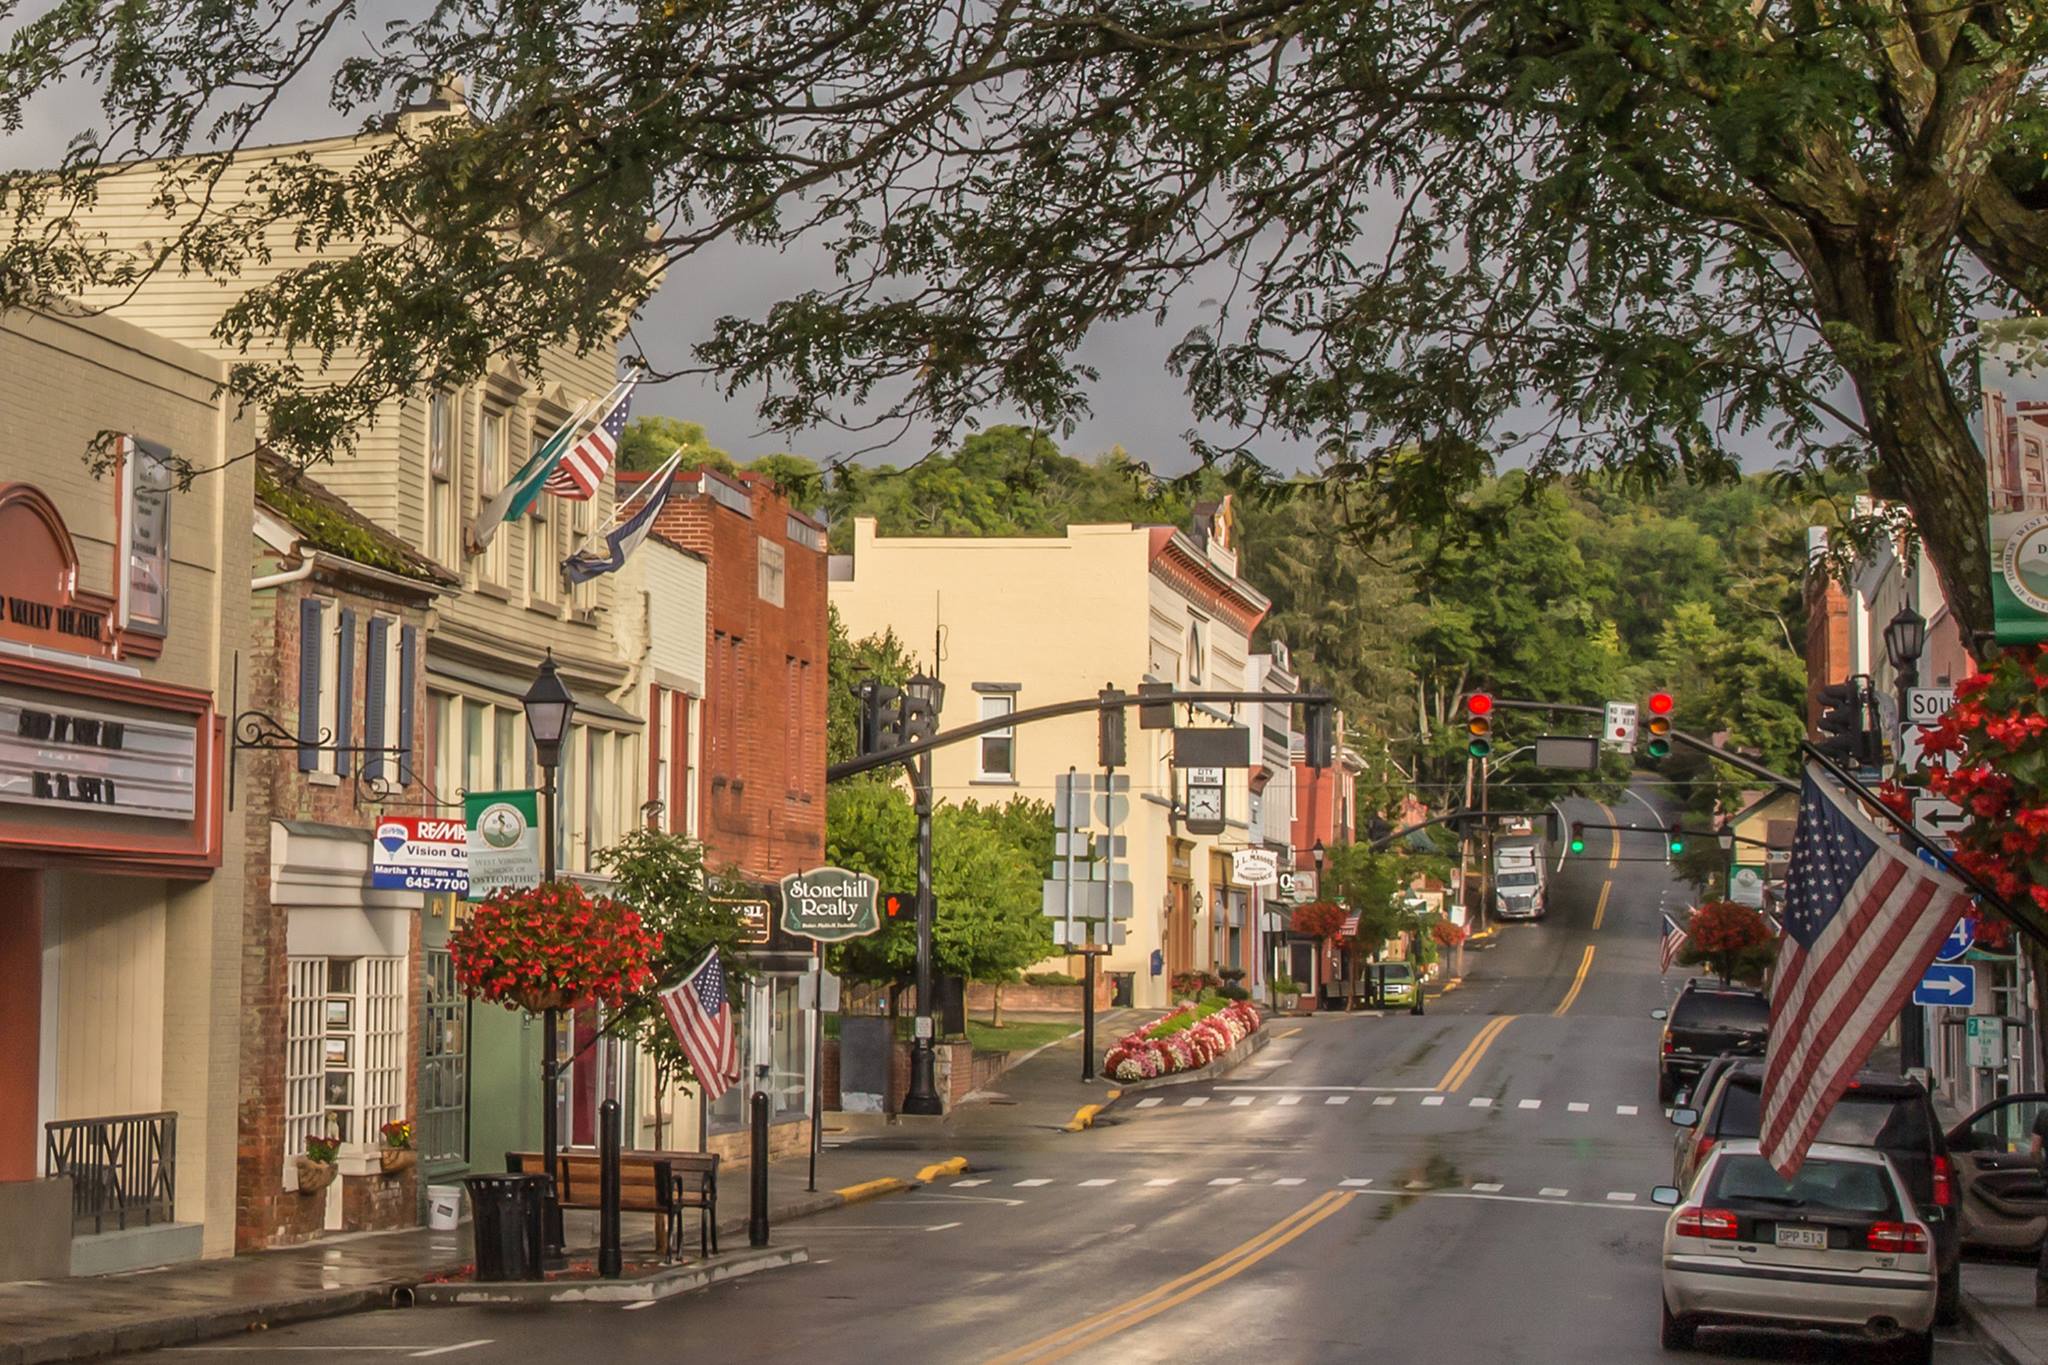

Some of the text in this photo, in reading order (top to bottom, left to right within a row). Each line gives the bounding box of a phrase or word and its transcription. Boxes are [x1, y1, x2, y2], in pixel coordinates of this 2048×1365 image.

[1913, 694, 1951, 715] SOU
[417, 821, 467, 840] RE/MA
[407, 845, 468, 858] Vision Qu
[374, 865, 408, 875] Martha
[420, 868, 449, 877] Hilton
[405, 876, 468, 891] 645-7700
[790, 880, 868, 898] Stonehill
[801, 898, 858, 921] Realty
[1803, 1231, 1824, 1244] 513
